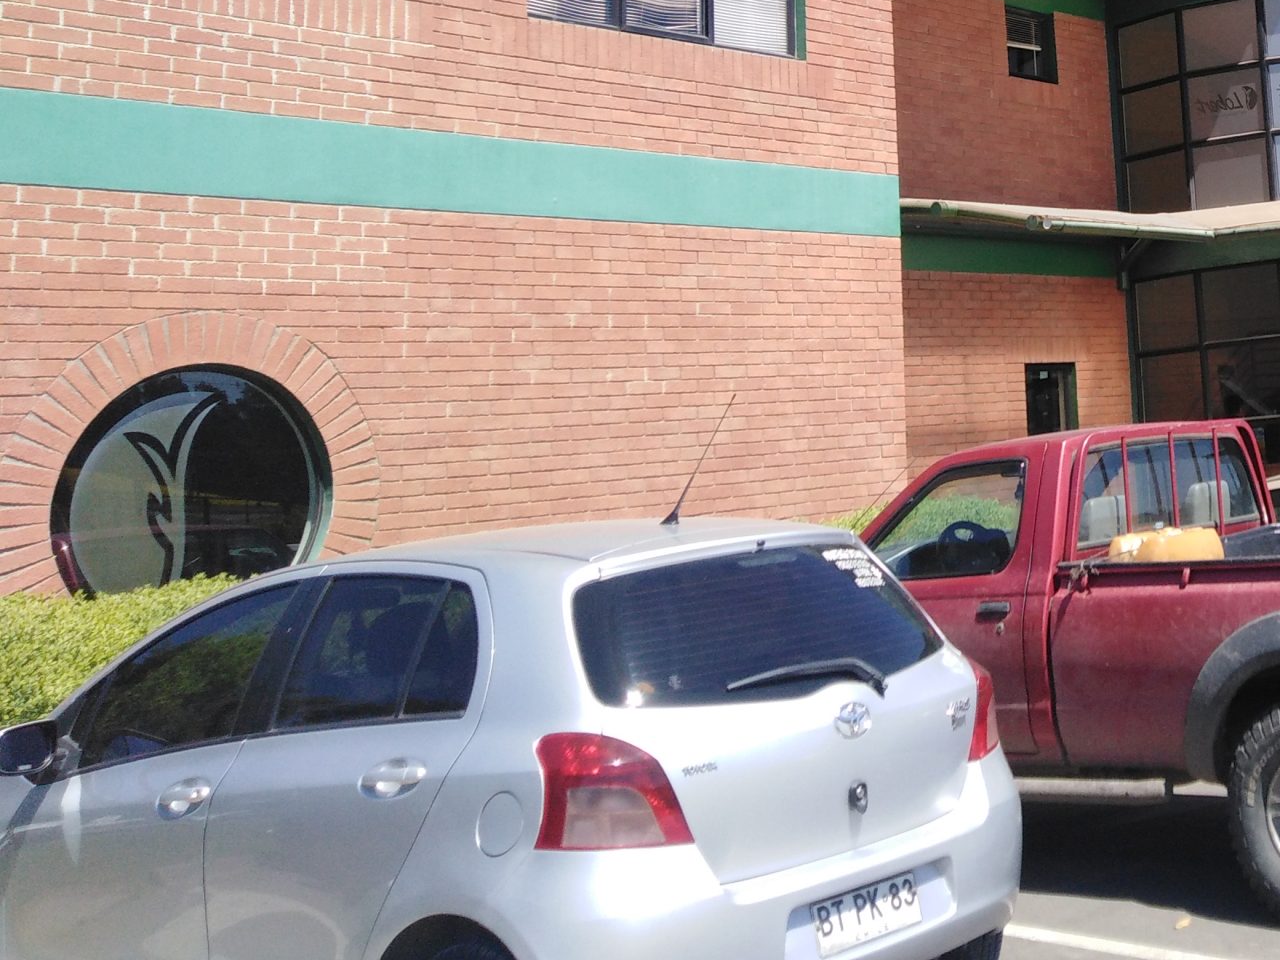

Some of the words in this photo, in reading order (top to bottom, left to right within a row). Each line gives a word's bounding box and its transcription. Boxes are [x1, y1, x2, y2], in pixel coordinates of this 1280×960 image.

[816, 898, 845, 938] BT
[852, 887, 884, 926] PK
[888, 878, 916, 911] 83
